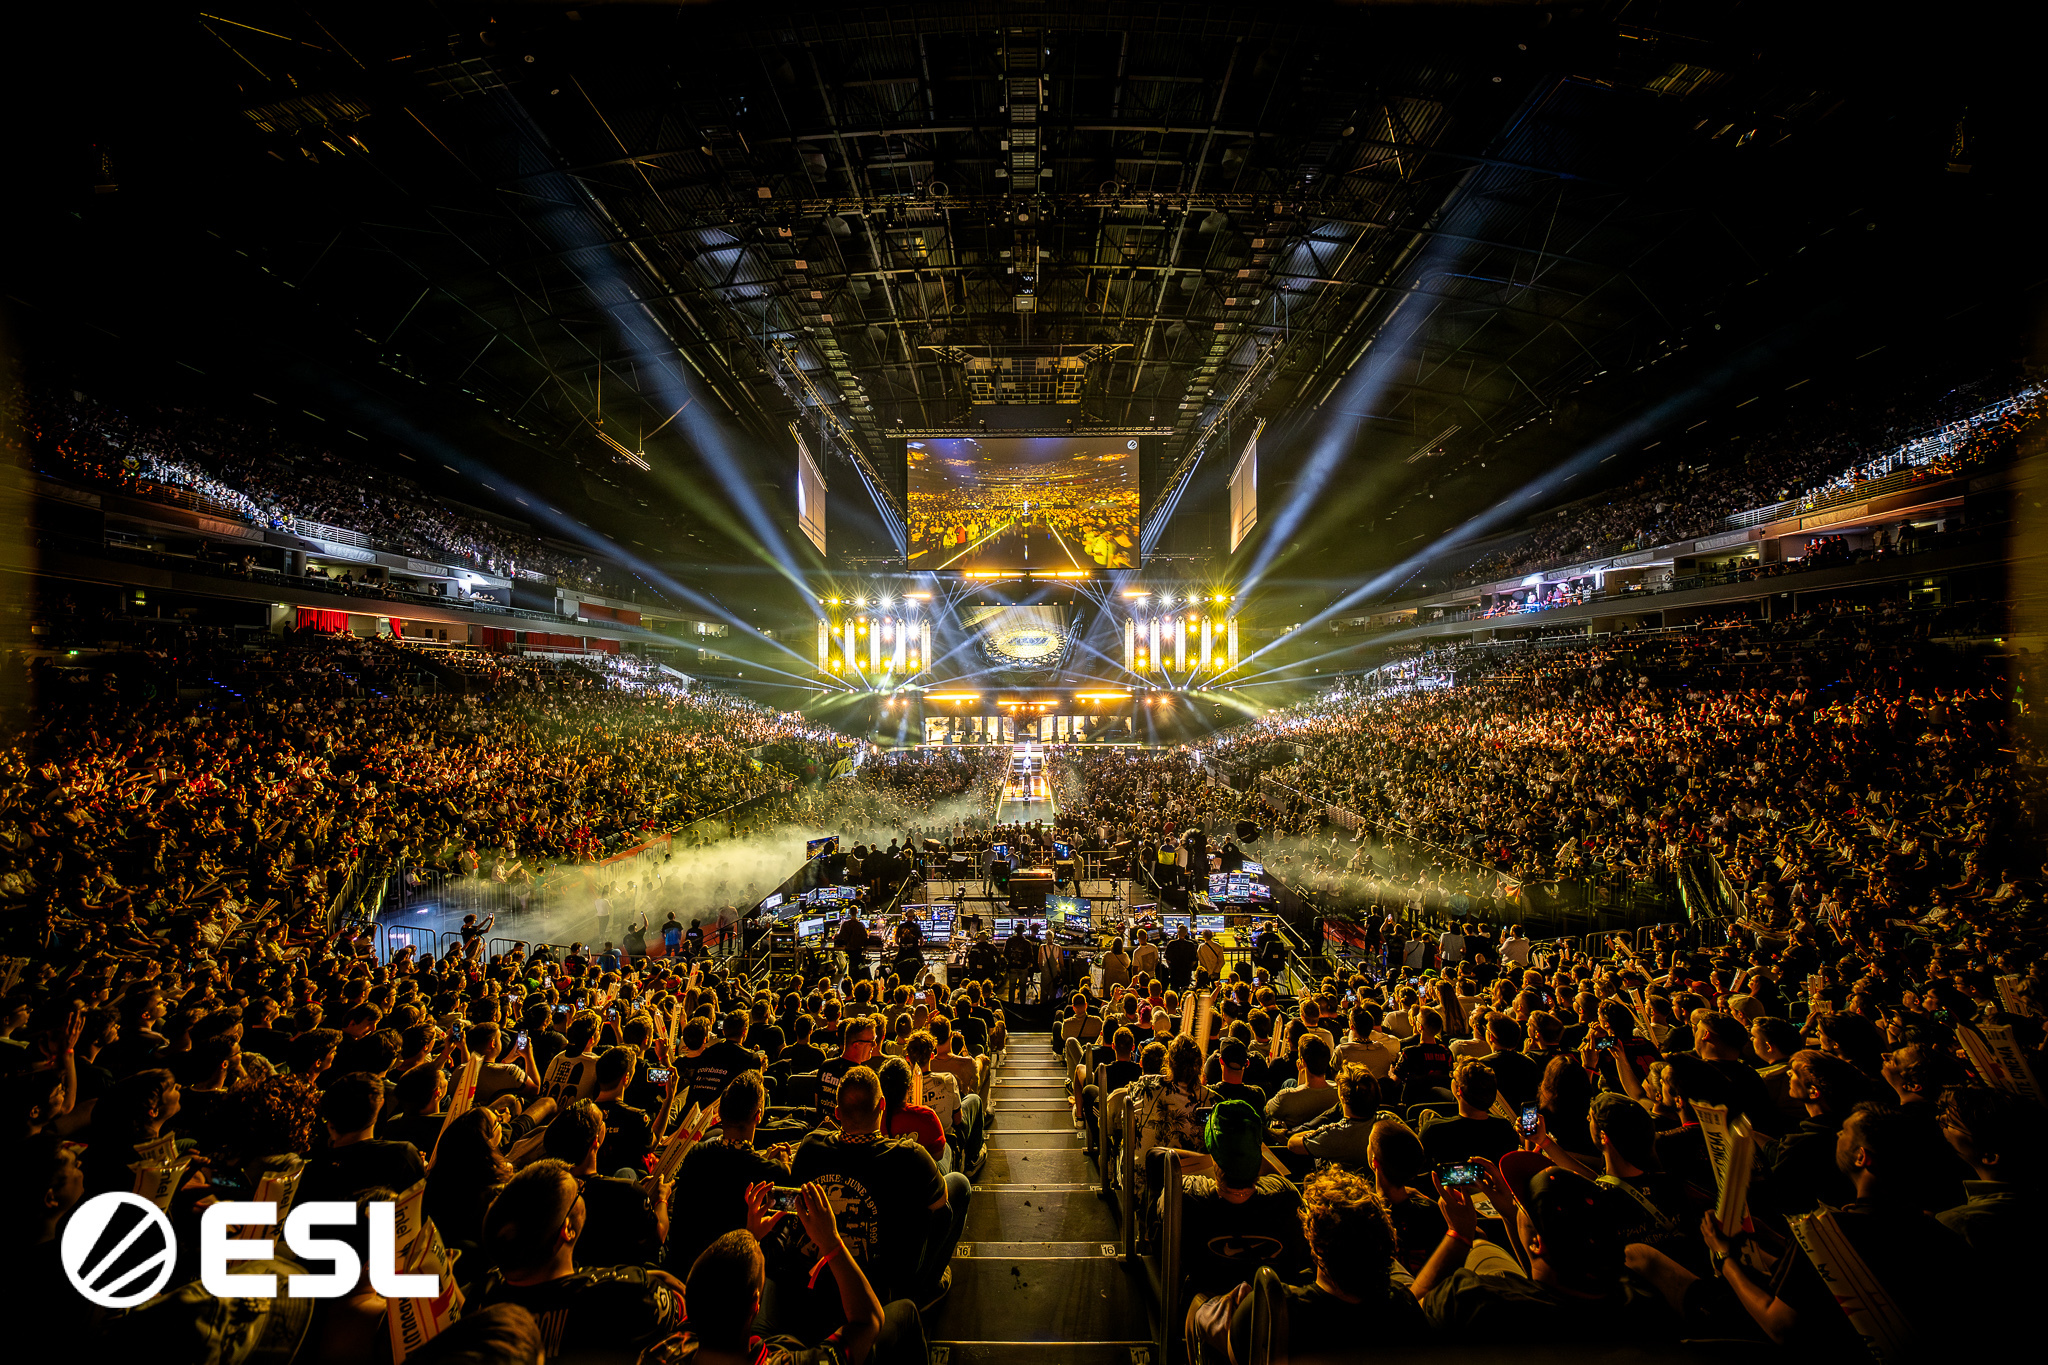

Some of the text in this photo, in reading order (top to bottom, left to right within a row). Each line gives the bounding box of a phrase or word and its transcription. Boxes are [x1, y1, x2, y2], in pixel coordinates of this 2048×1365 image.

[1997, 1046, 2027, 1080] CINEMA
[1794, 1224, 1814, 1254] intel
[958, 1245, 969, 1256] 16
[1103, 1245, 1115, 1255] 16
[933, 1348, 947, 1364] 17
[1133, 1349, 1147, 1364] 17
